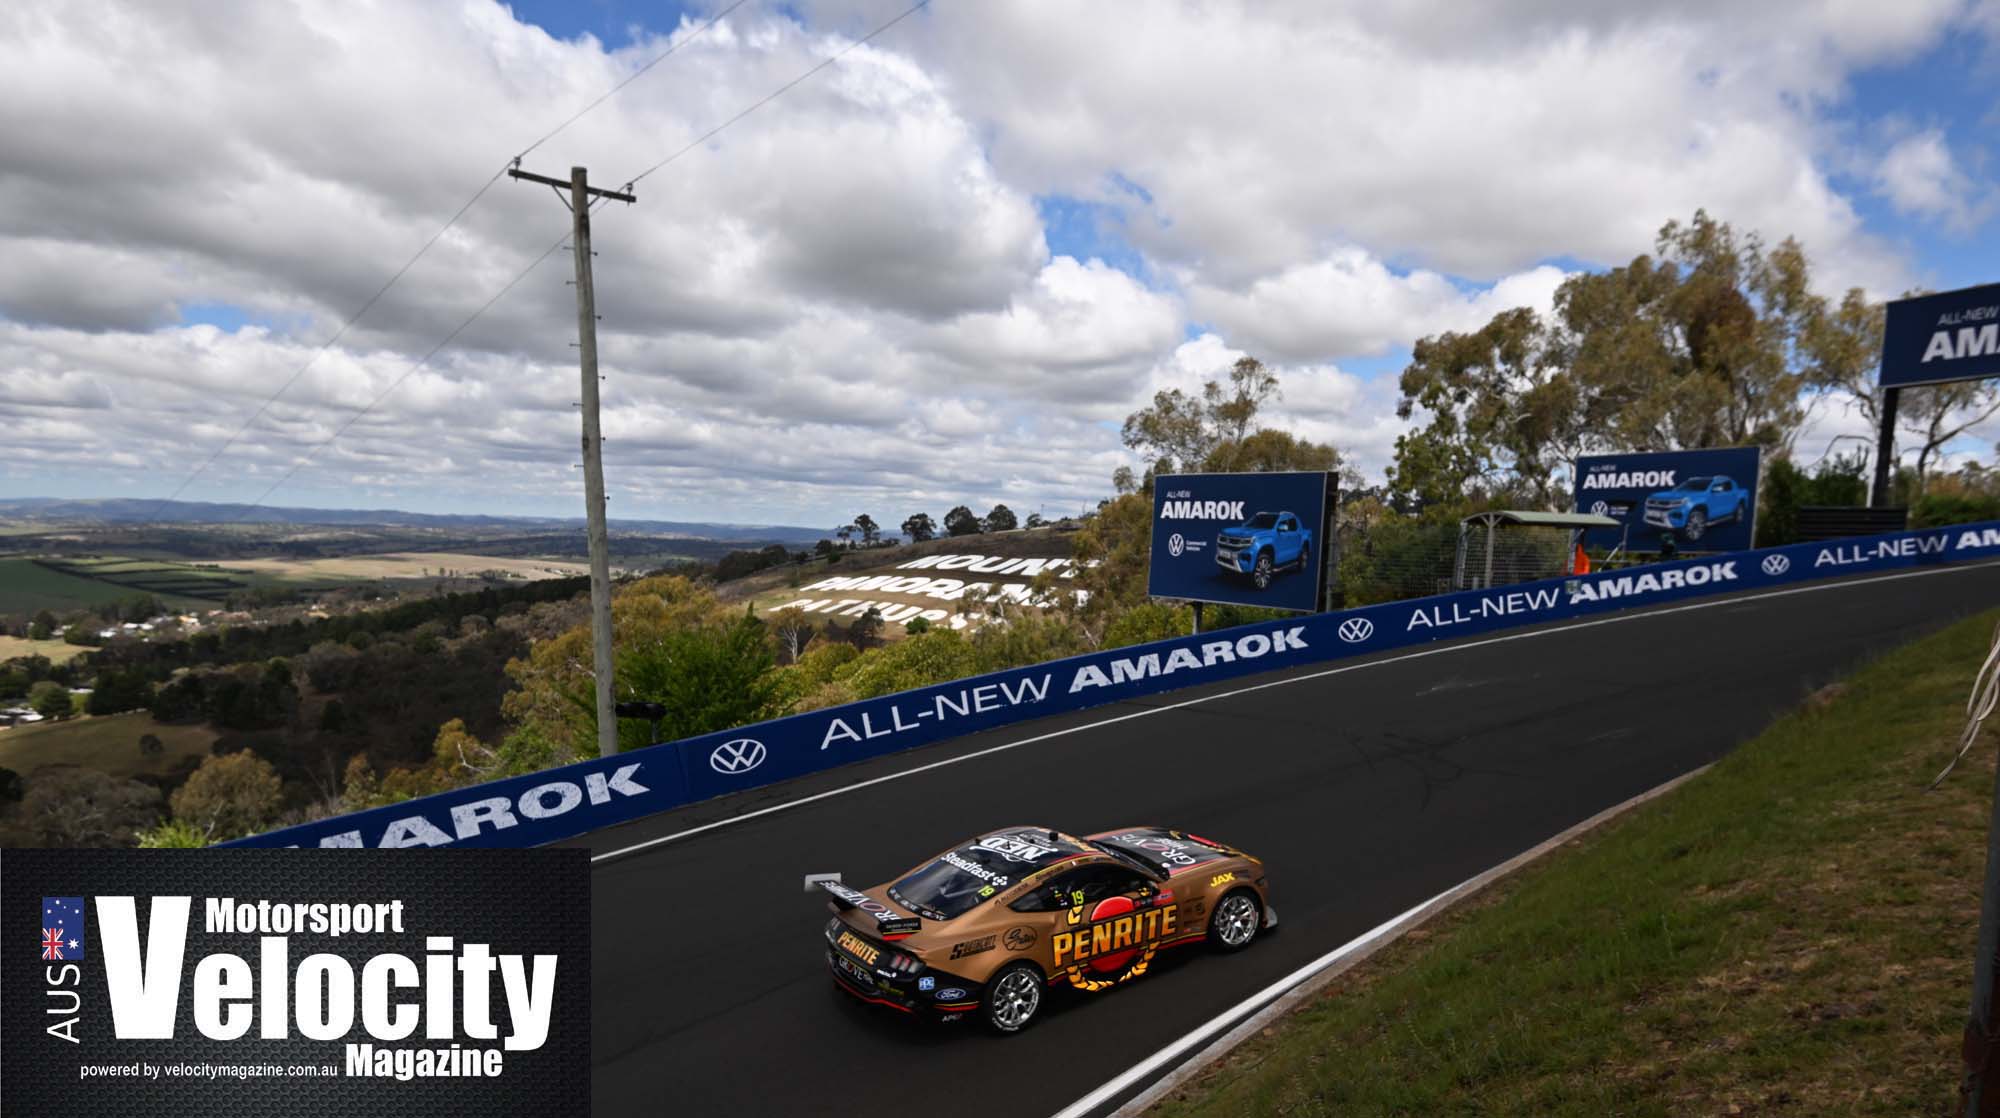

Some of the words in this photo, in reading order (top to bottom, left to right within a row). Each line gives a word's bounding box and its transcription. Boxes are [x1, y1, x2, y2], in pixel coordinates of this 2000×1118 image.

[1936, 306, 1999, 326] ALL-NEW
[1921, 323, 2000, 363] AM
[1582, 470, 1676, 490] AMAROK
[1166, 490, 1191, 499] ALL-NEW
[1160, 501, 1245, 521] AMAROK
[1814, 535, 1949, 567] ALL-NEW
[1406, 588, 1559, 631] ALL-NEW
[1569, 561, 1738, 604] AMAROK
[820, 674, 1052, 750] ALL-NEW
[1069, 626, 1309, 694] AMAROK
[941, 852, 996, 881] Steadfast
[978, 884, 995, 897] 19
[1210, 872, 1236, 888] JAX
[1071, 889, 1084, 905] 19
[1053, 903, 1178, 968] PENRITE
[837, 931, 881, 966] PENRITE
